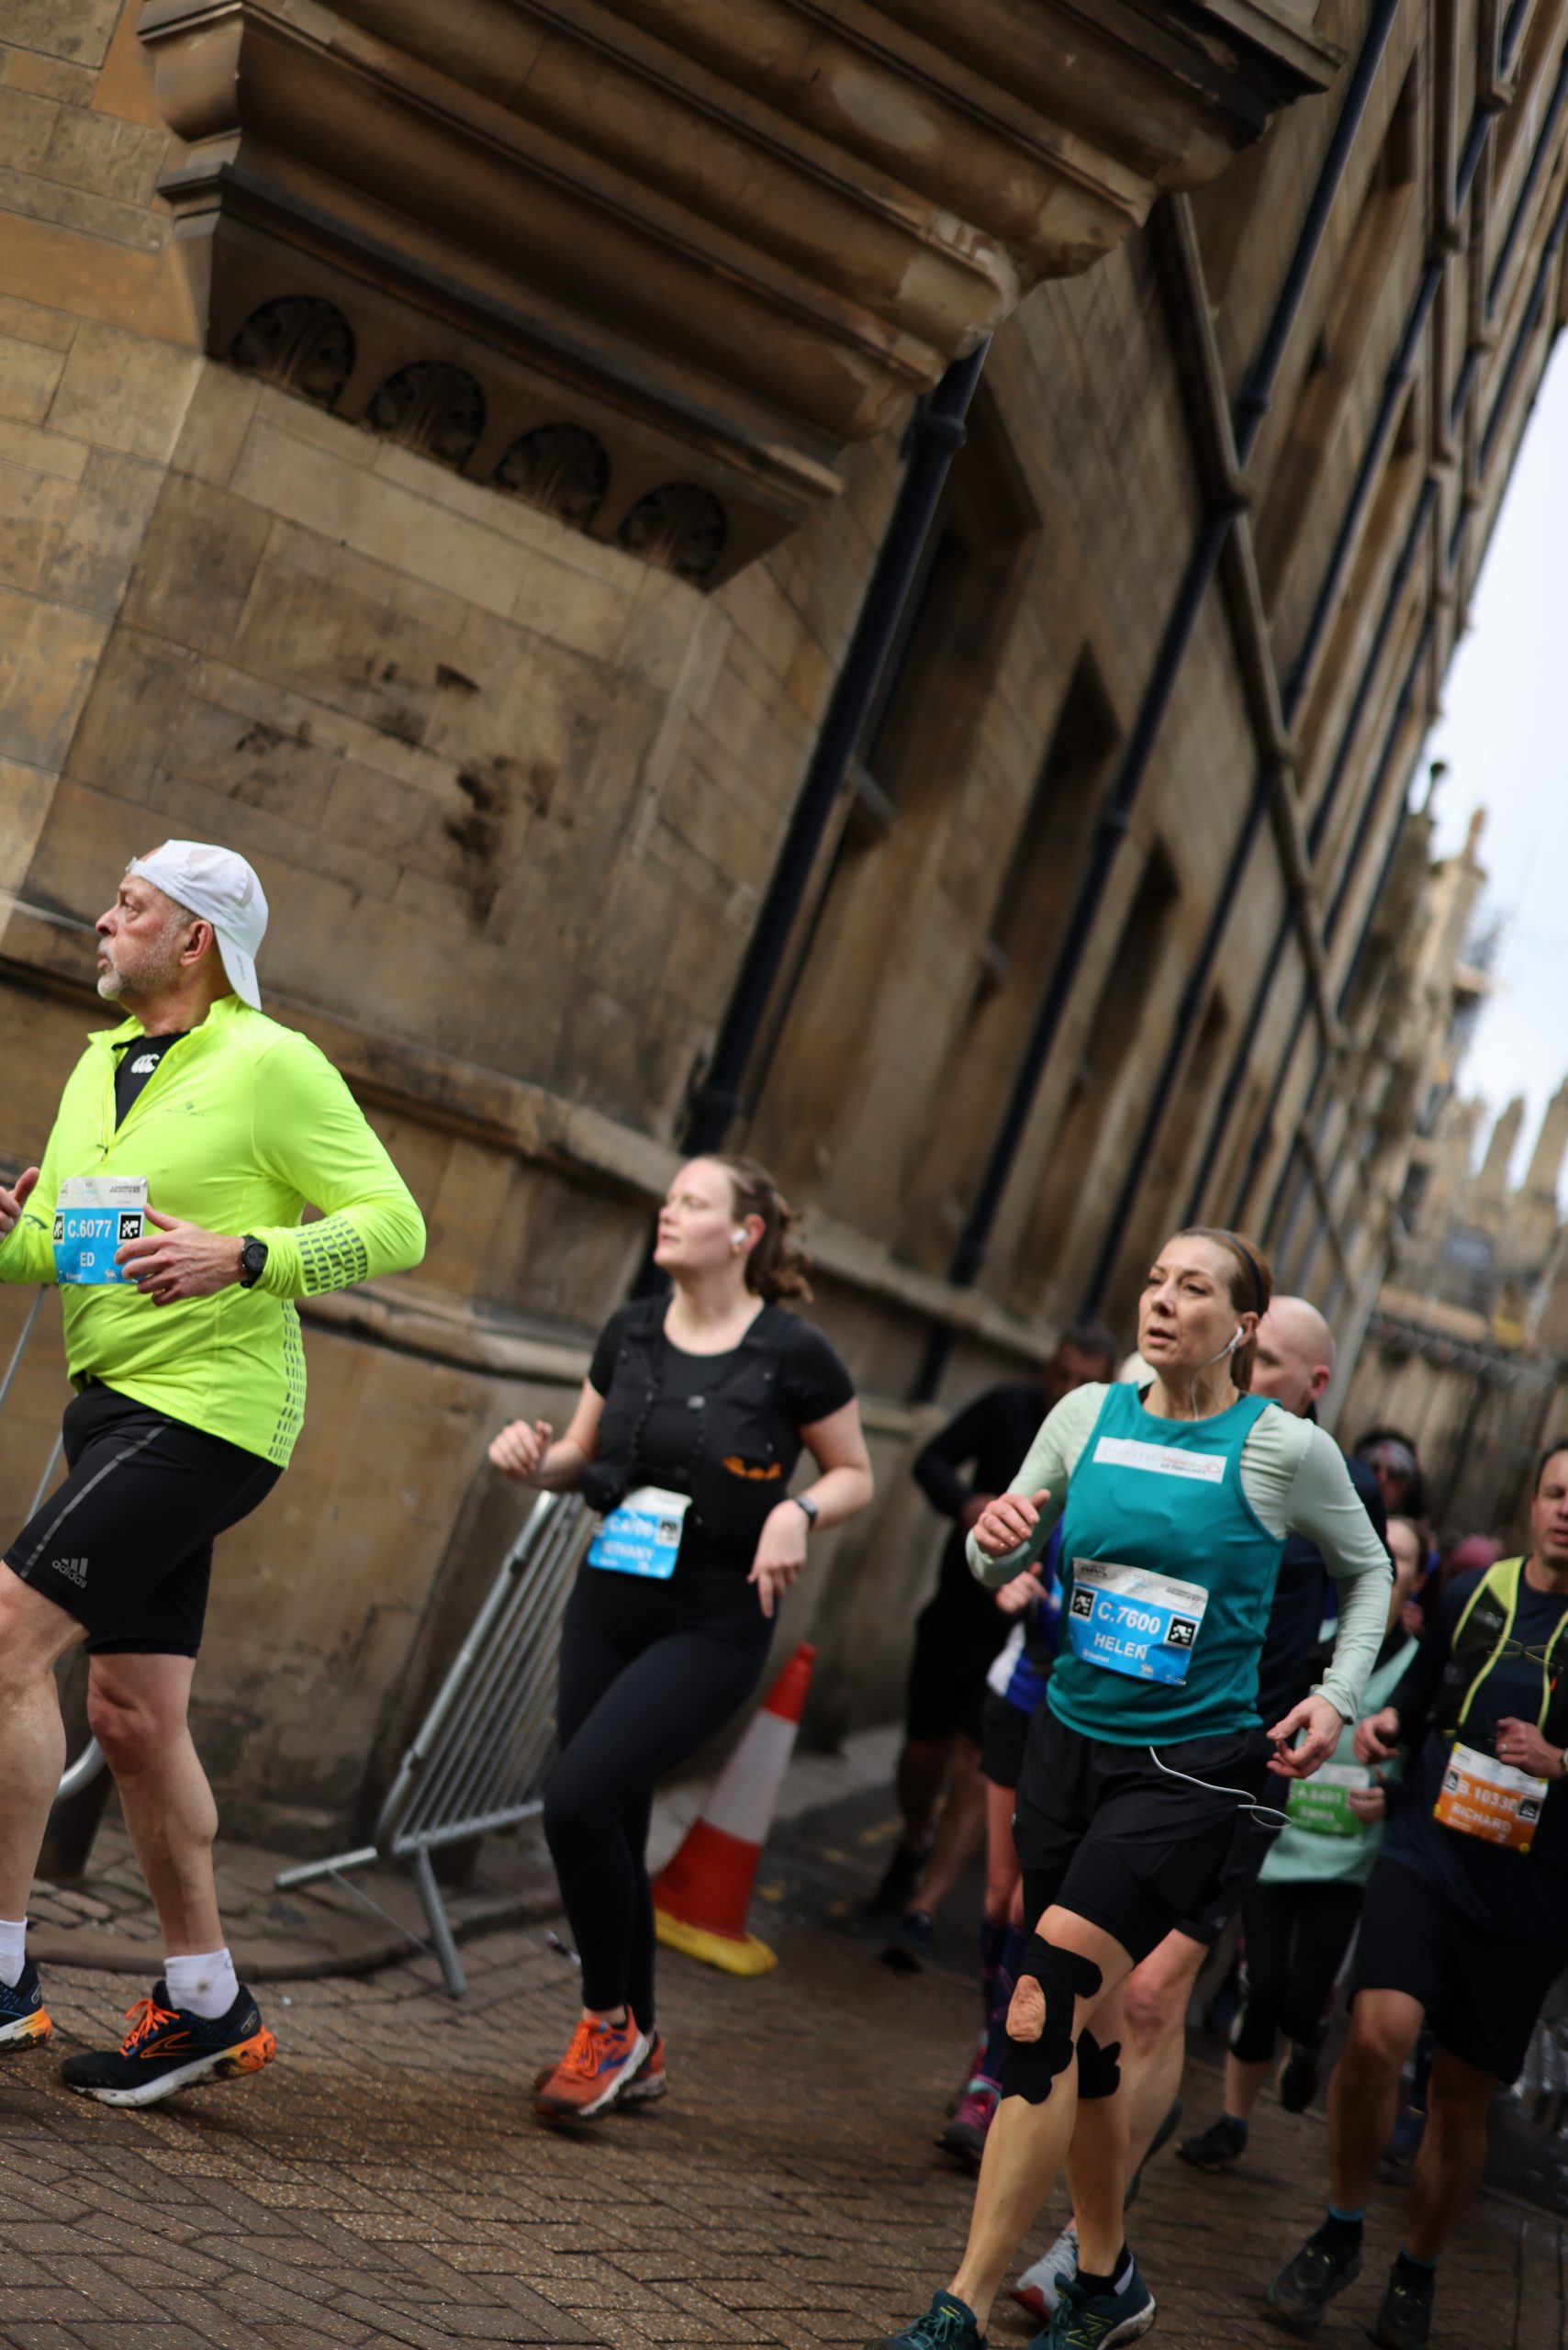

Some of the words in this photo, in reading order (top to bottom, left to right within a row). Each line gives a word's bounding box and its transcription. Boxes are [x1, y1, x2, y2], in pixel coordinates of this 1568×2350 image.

[67, 1219, 112, 1238] C.6077
[79, 1251, 95, 1267] ED
[51, 1560, 87, 1588] adidas
[1097, 1601, 1161, 1635] C.7600
[1093, 1632, 1148, 1661] HELEN
[1450, 1801, 1513, 1832] RICHARD
